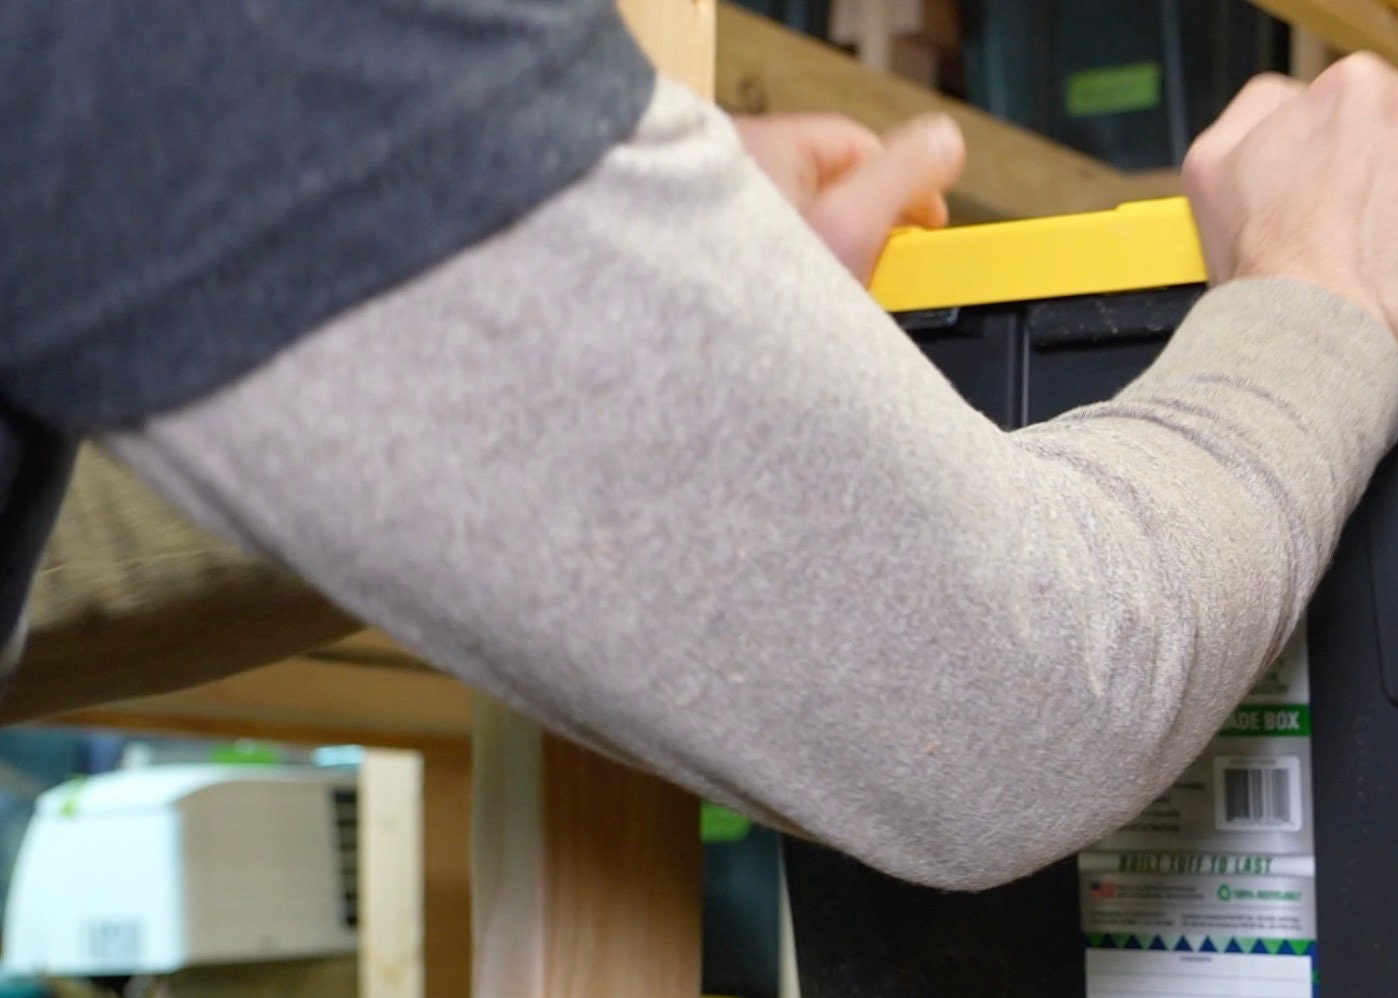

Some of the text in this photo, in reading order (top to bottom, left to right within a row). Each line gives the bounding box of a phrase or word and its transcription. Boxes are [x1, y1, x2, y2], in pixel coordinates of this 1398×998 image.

[1264, 711, 1300, 731] BOX
[1211, 857, 1228, 874] TO
[1235, 858, 1272, 875] LAST
